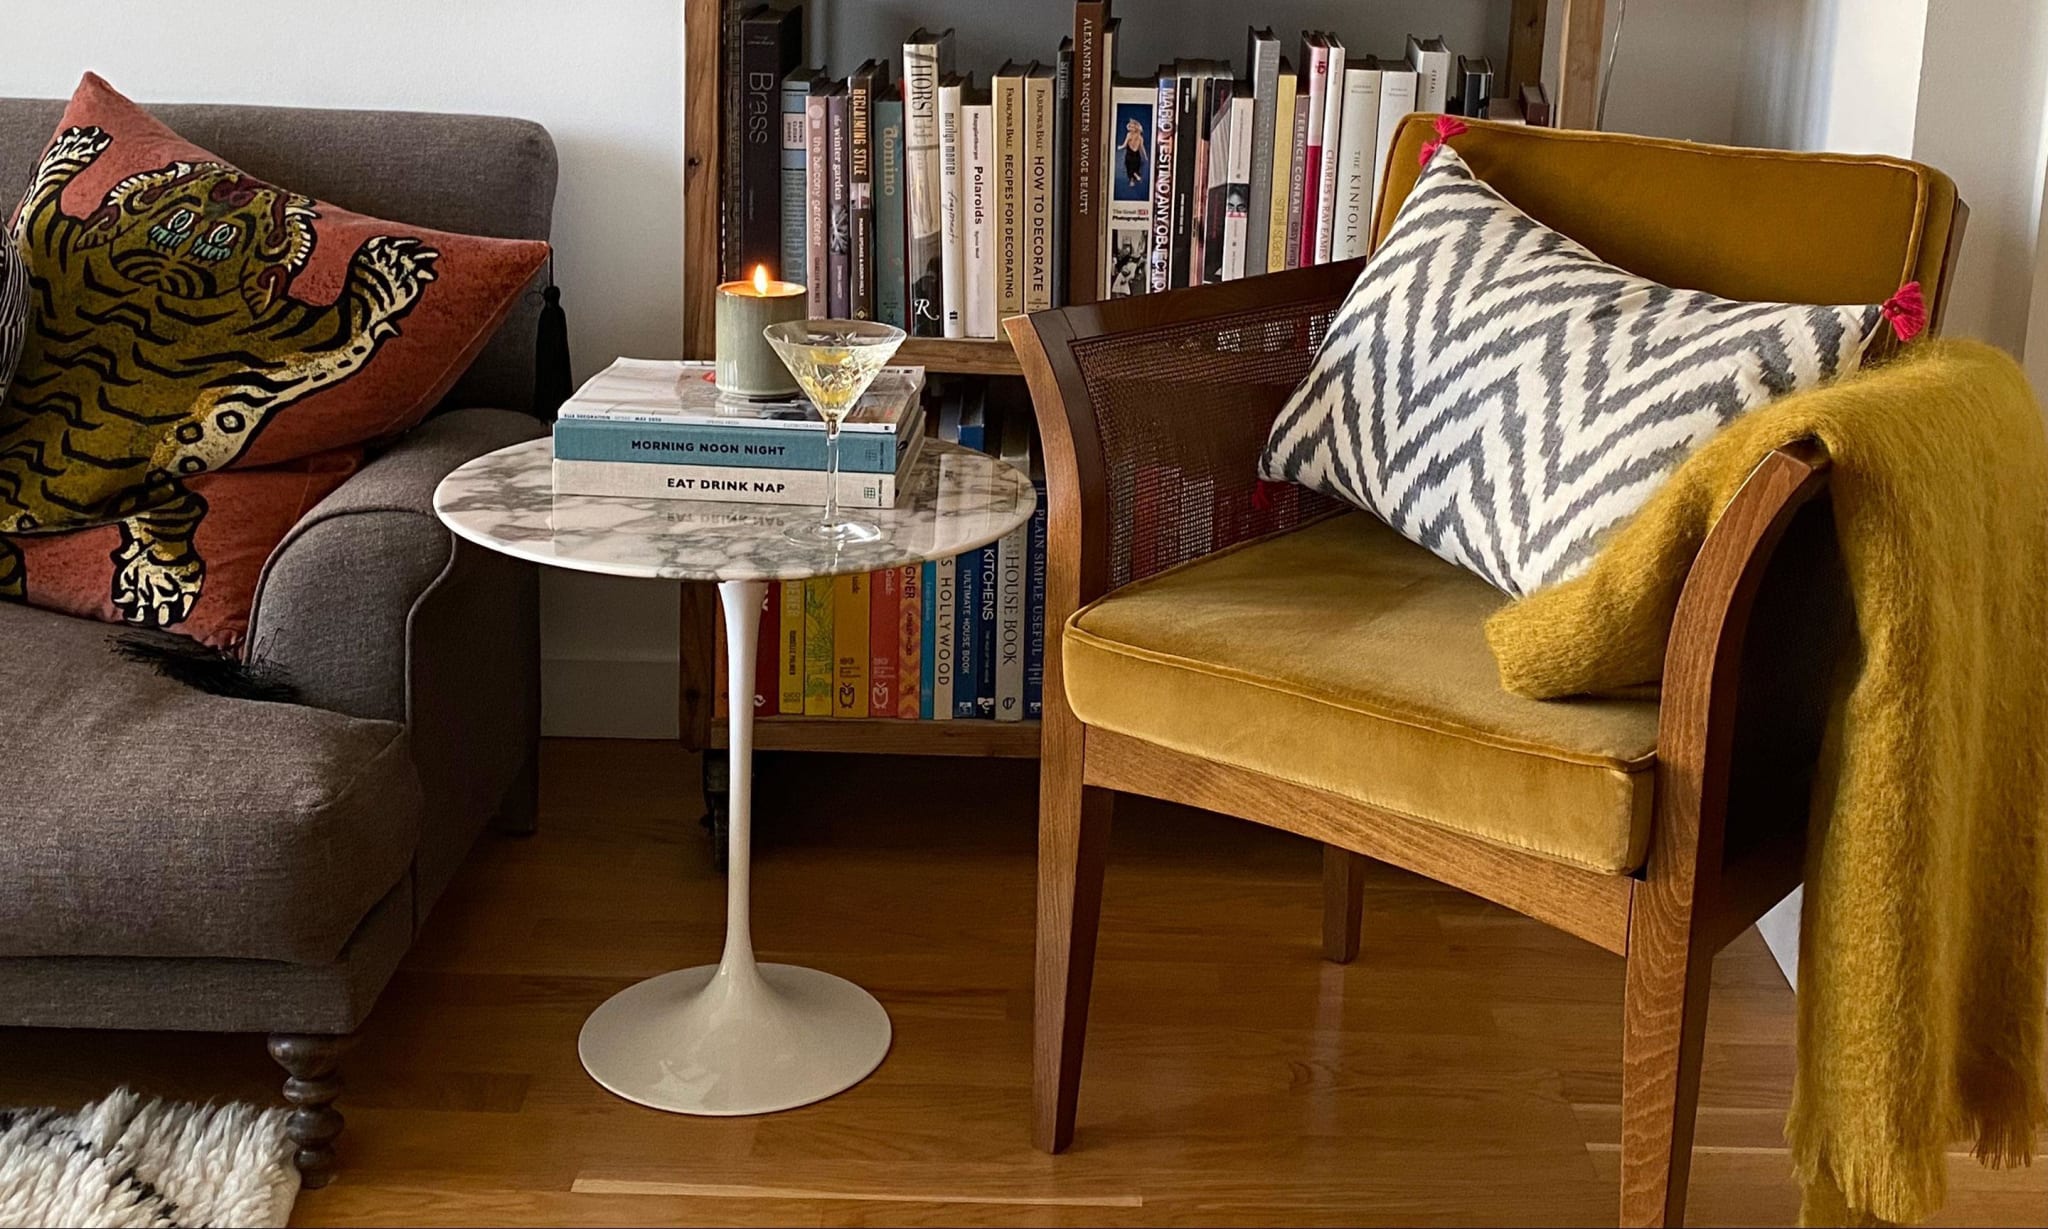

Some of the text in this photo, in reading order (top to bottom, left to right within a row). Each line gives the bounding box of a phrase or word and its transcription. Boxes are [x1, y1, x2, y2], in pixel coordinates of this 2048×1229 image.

[1083, 18, 1093, 82] ALEXANDER
[749, 72, 774, 144] Brass
[911, 65, 933, 118] HORST
[833, 127, 844, 163] winter
[853, 89, 867, 176] RECLAIMING STYLE
[943, 112, 958, 176] marilyn monroe
[1080, 137, 1089, 173] SAVAGE
[1296, 111, 1306, 161] TERENCE
[832, 164, 844, 200] garden
[884, 125, 899, 196] domino
[1005, 154, 1014, 200] RECIPES
[1034, 156, 1044, 191] HOW
[1324, 149, 1335, 194] CHARLES
[811, 136, 823, 247] the balcony gardener
[974, 166, 984, 225] Polaroids
[1034, 195, 1044, 213] TO
[1080, 176, 1089, 216] BEAUTY
[1151, 87, 1175, 293] MARIO TESTINO ANY OBJECTIO
[1292, 166, 1302, 214] CONRAN
[1346, 174, 1361, 243] KINFOLK
[1005, 203, 1014, 225] FOR
[1321, 206, 1330, 225] RAY
[1005, 228, 1014, 298] DECORATING
[1033, 217, 1044, 292] DECORATE
[1319, 228, 1329, 260] EAMES
[914, 298, 940, 321] R
[631, 440, 785, 456] MORNING NOON NIGHT
[667, 478, 785, 493] EAT DRINK NAP
[1034, 508, 1046, 549] PLAIN
[962, 574, 971, 615] ULTIMATE
[982, 549, 995, 621] KITCHENS
[1003, 556, 1019, 615] HOUSE
[1033, 553, 1045, 602] SIMPLE
[938, 577, 952, 685] HOLLYWOOD
[962, 617, 970, 648] HOUSE
[1003, 620, 1017, 666] BOOK
[1031, 605, 1043, 656] USEFUL
[962, 649, 970, 674] BOOK
